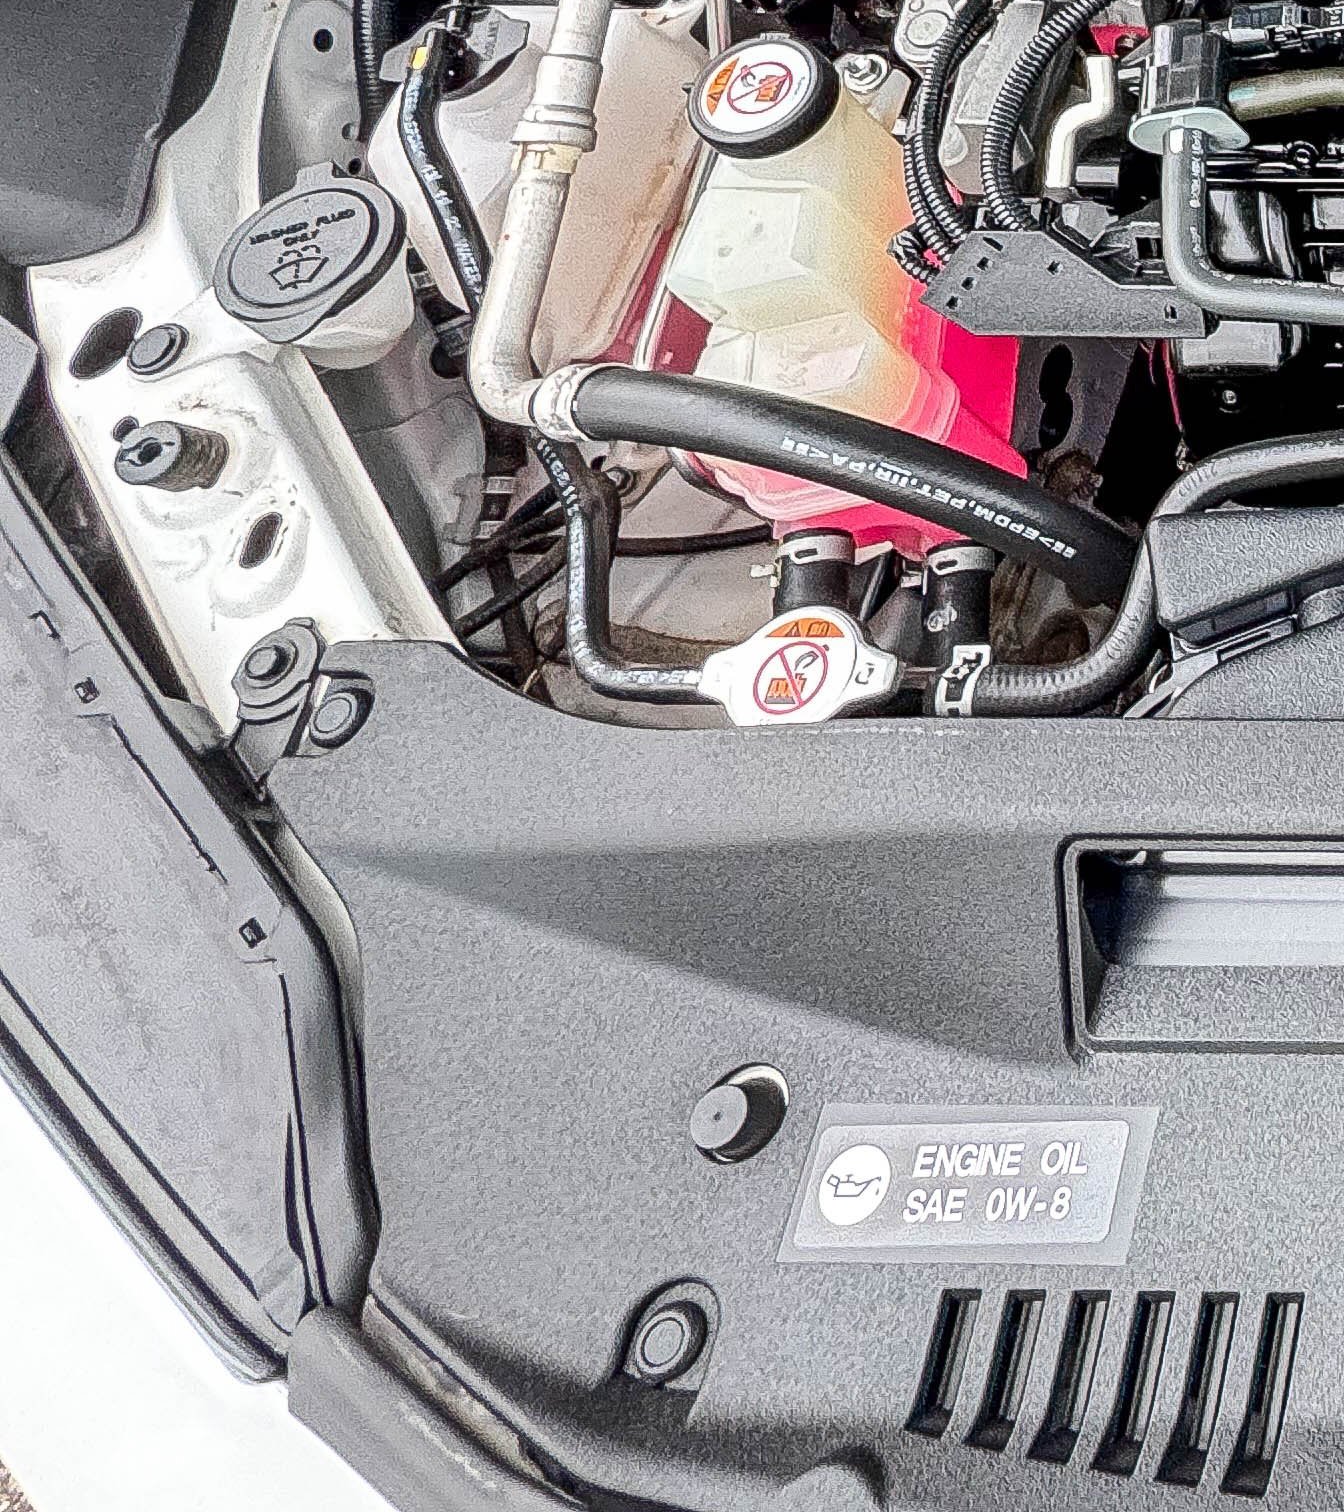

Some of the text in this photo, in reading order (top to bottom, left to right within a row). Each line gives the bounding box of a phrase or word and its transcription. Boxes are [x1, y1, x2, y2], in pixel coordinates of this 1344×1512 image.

[912, 1140, 1089, 1179] ENGINE OIL
[902, 1185, 1073, 1224] SAE 0W-8
